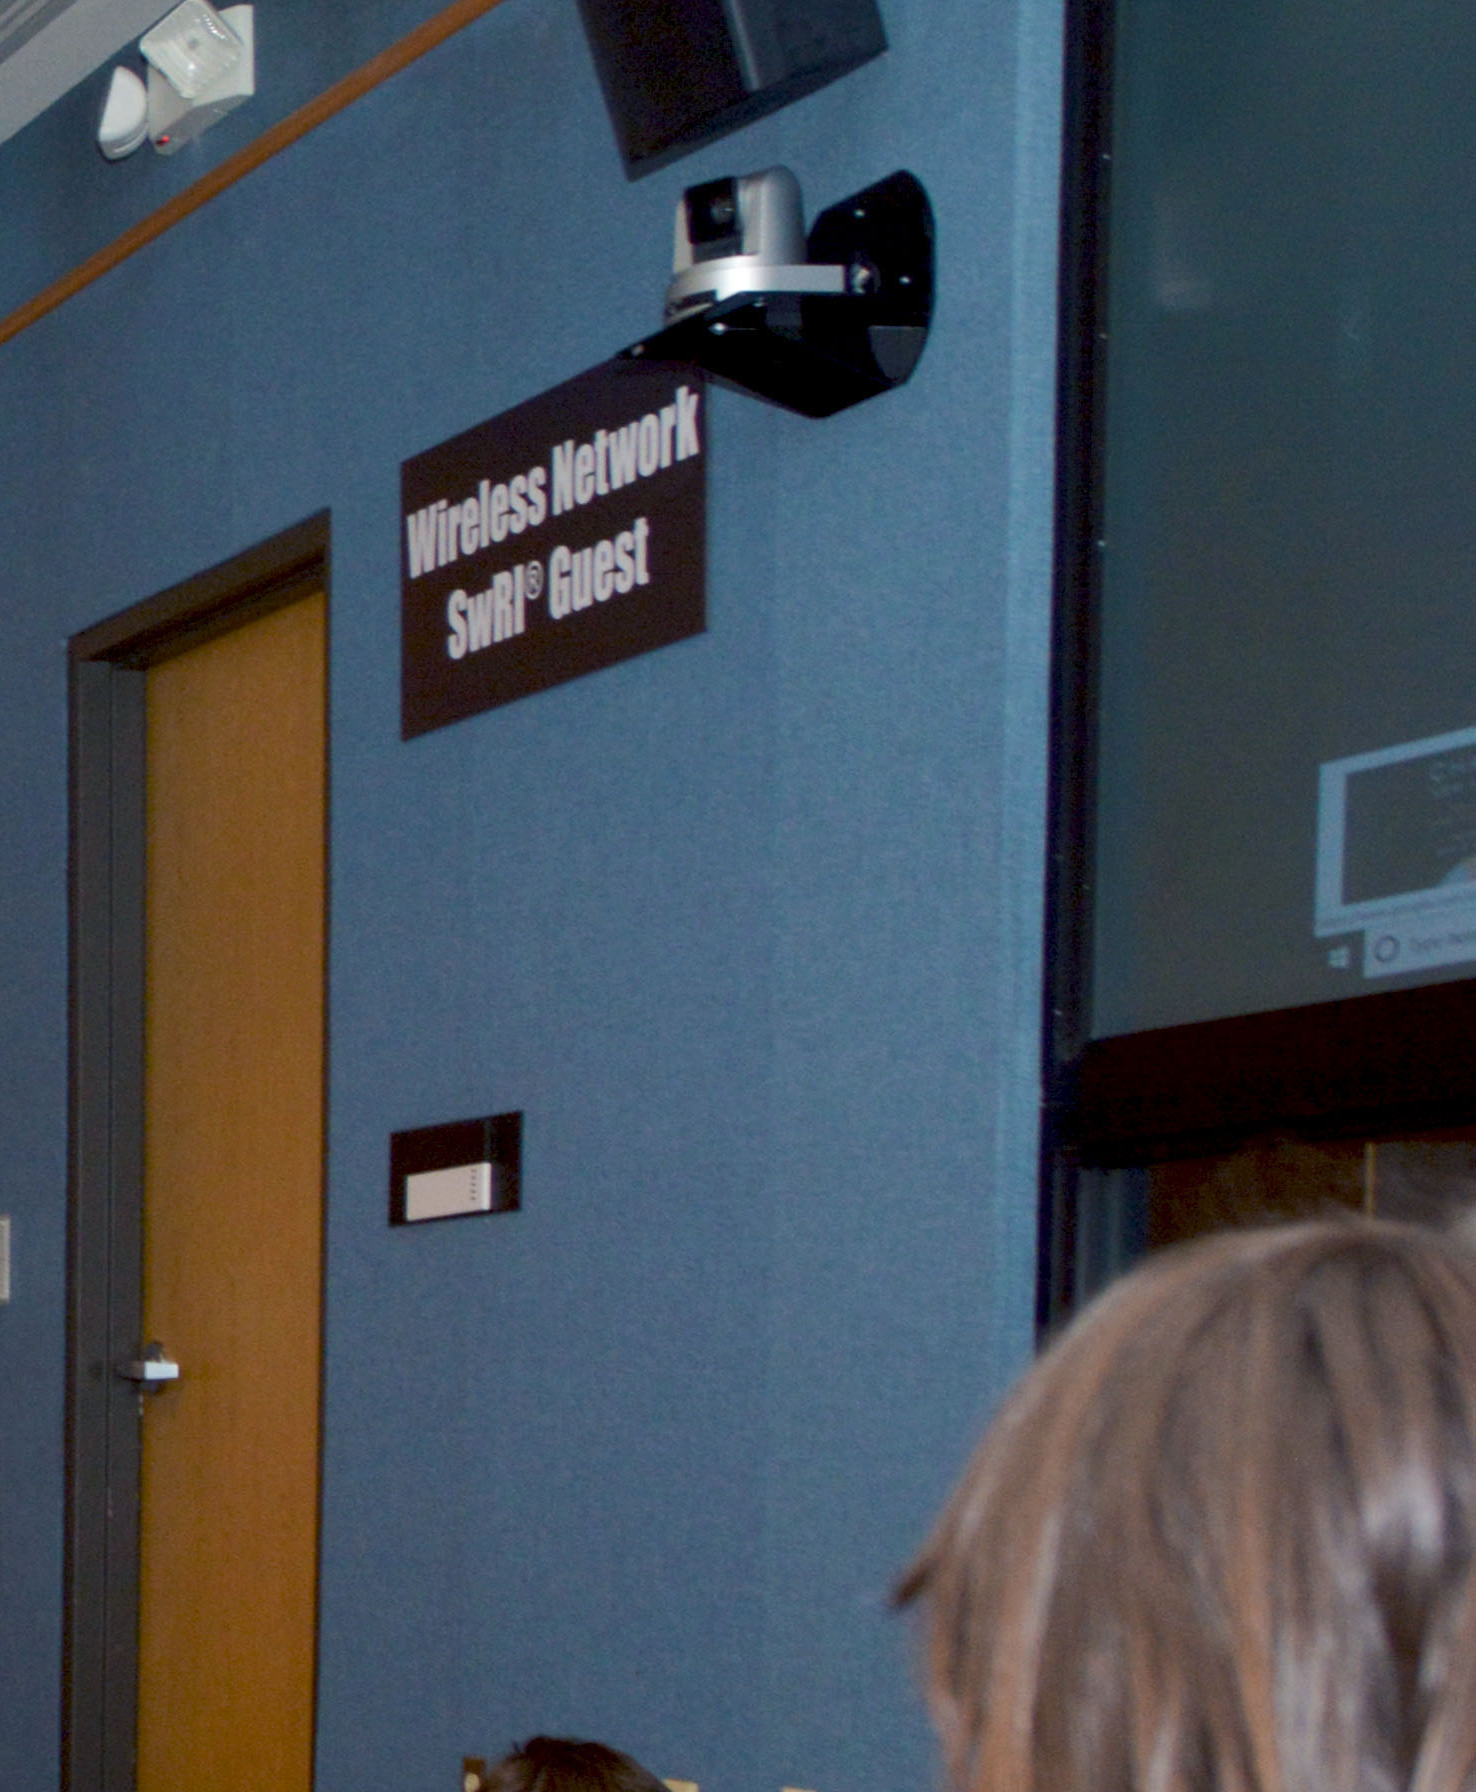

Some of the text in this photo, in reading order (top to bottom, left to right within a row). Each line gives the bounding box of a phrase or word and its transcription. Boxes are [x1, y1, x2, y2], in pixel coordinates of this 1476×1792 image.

[406, 384, 701, 580] Wireless Network
[548, 516, 650, 621] Guest
